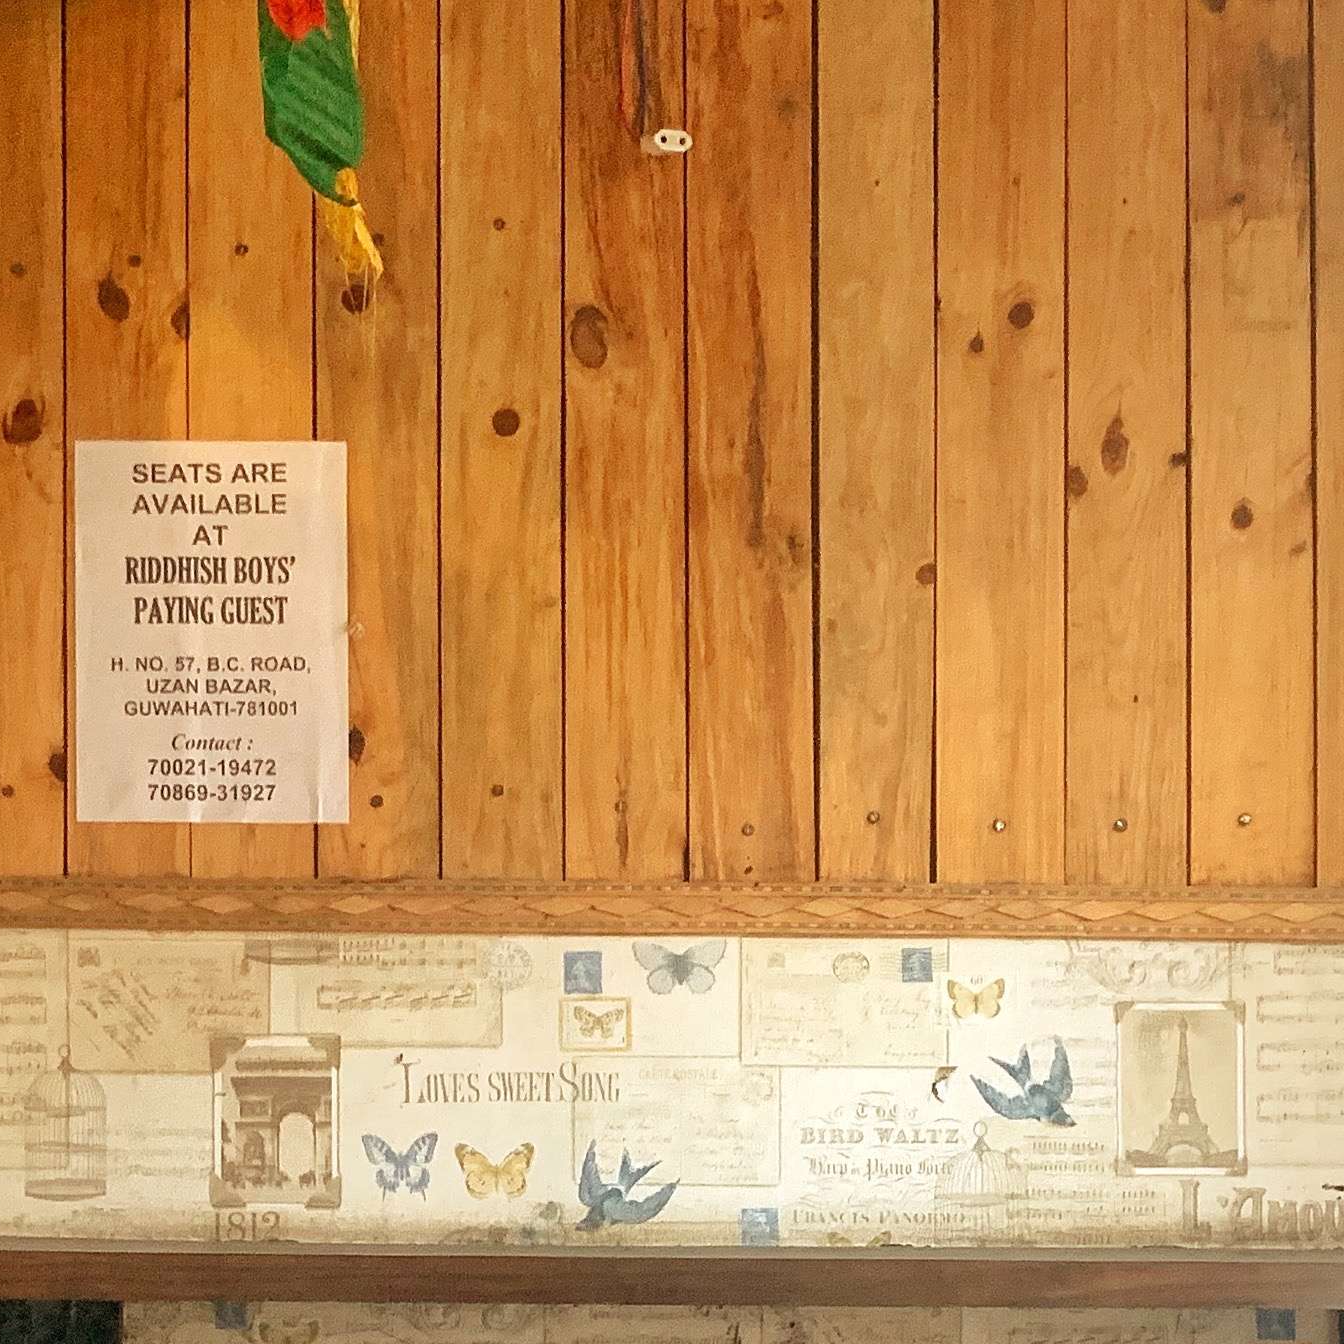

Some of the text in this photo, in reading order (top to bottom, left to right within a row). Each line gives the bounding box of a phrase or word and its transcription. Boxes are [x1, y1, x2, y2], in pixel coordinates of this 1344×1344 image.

[132, 463, 287, 483] SEATS ARE
[132, 494, 287, 515] AVAILABLE
[192, 525, 228, 546] AT
[124, 556, 228, 584] RIDDHISH
[134, 596, 288, 625] PAYING GUEST
[111, 657, 311, 675] H. NO. 57, B.C. ROAD,
[146, 679, 277, 697] UZAN BAZAR,
[124, 701, 299, 717] GUWAHATI-781001
[171, 733, 242, 751] Contact
[147, 759, 277, 777] 70021-19472
[147, 784, 278, 802] 70869-31927
[800, 1127, 864, 1145] BIRD
[214, 1211, 281, 1242] 1812
